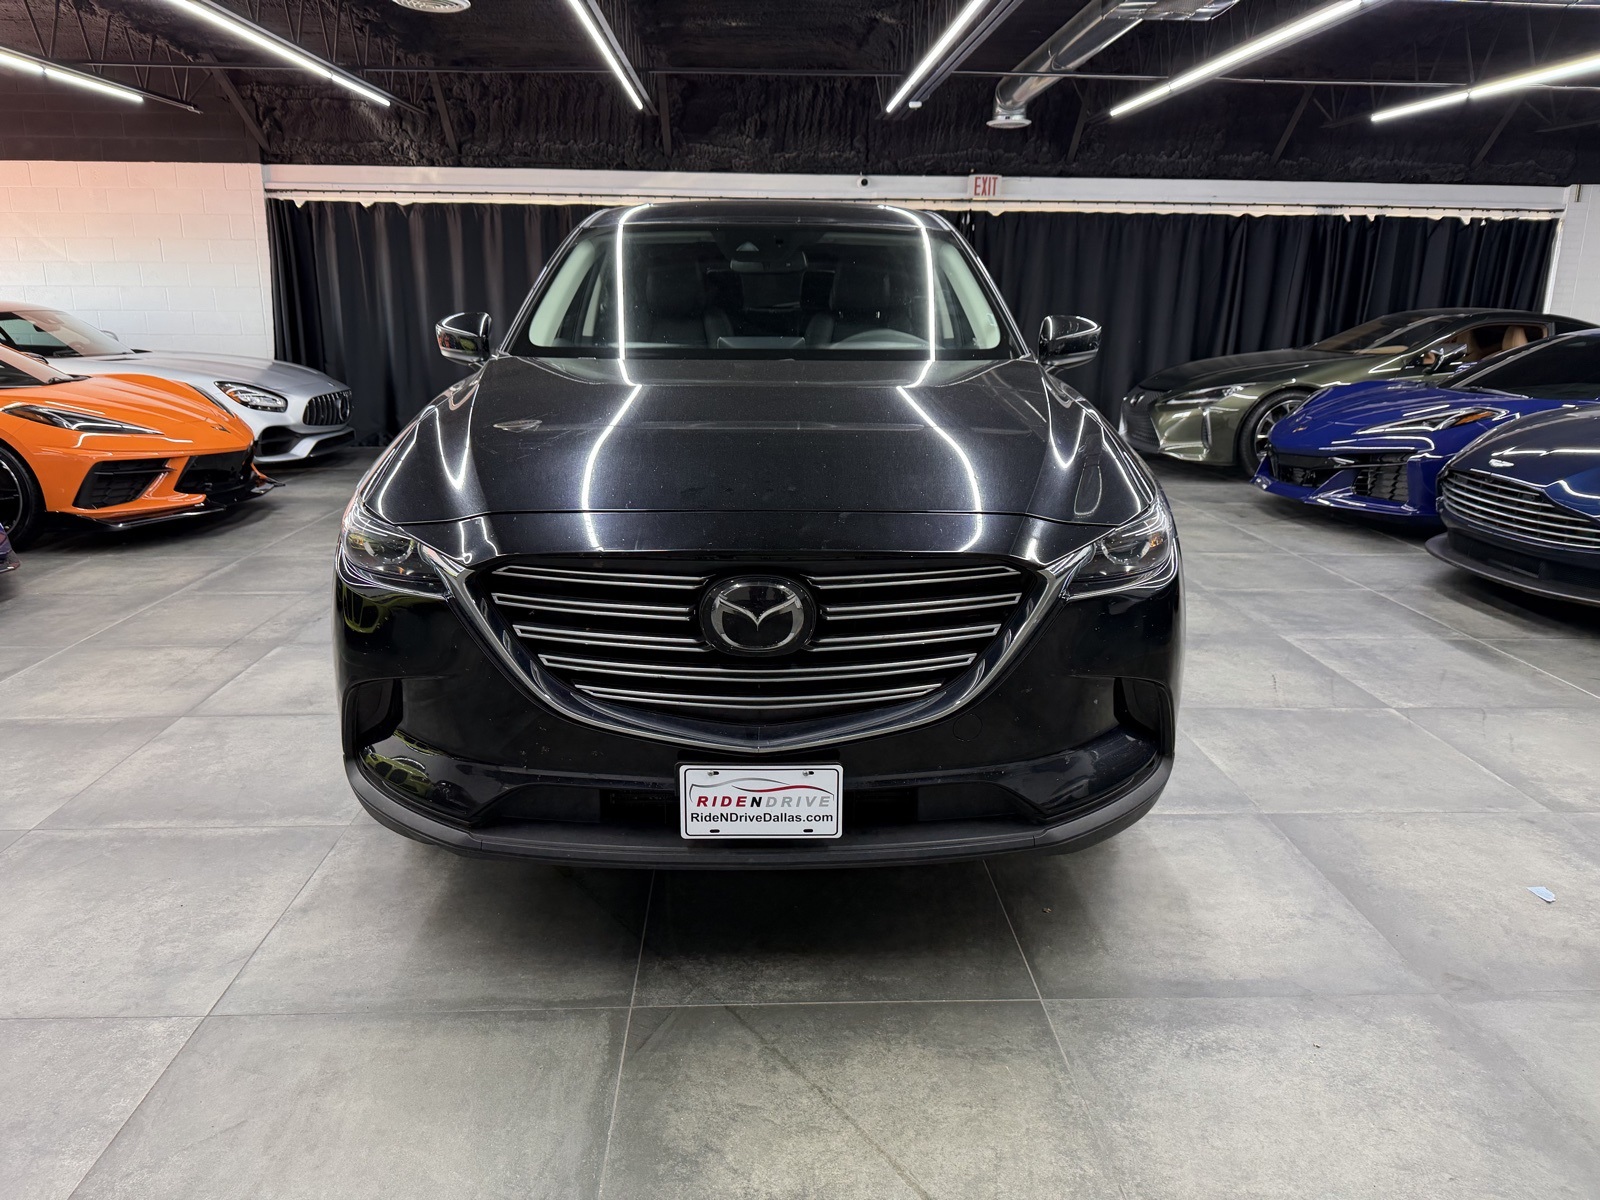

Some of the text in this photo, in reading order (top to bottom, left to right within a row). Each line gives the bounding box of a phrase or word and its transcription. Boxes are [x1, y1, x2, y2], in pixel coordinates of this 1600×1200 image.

[974, 176, 998, 196] EXIT
[696, 796, 830, 807] RIDENDRIVE
[690, 812, 833, 823] RideNDriveDallas.com
